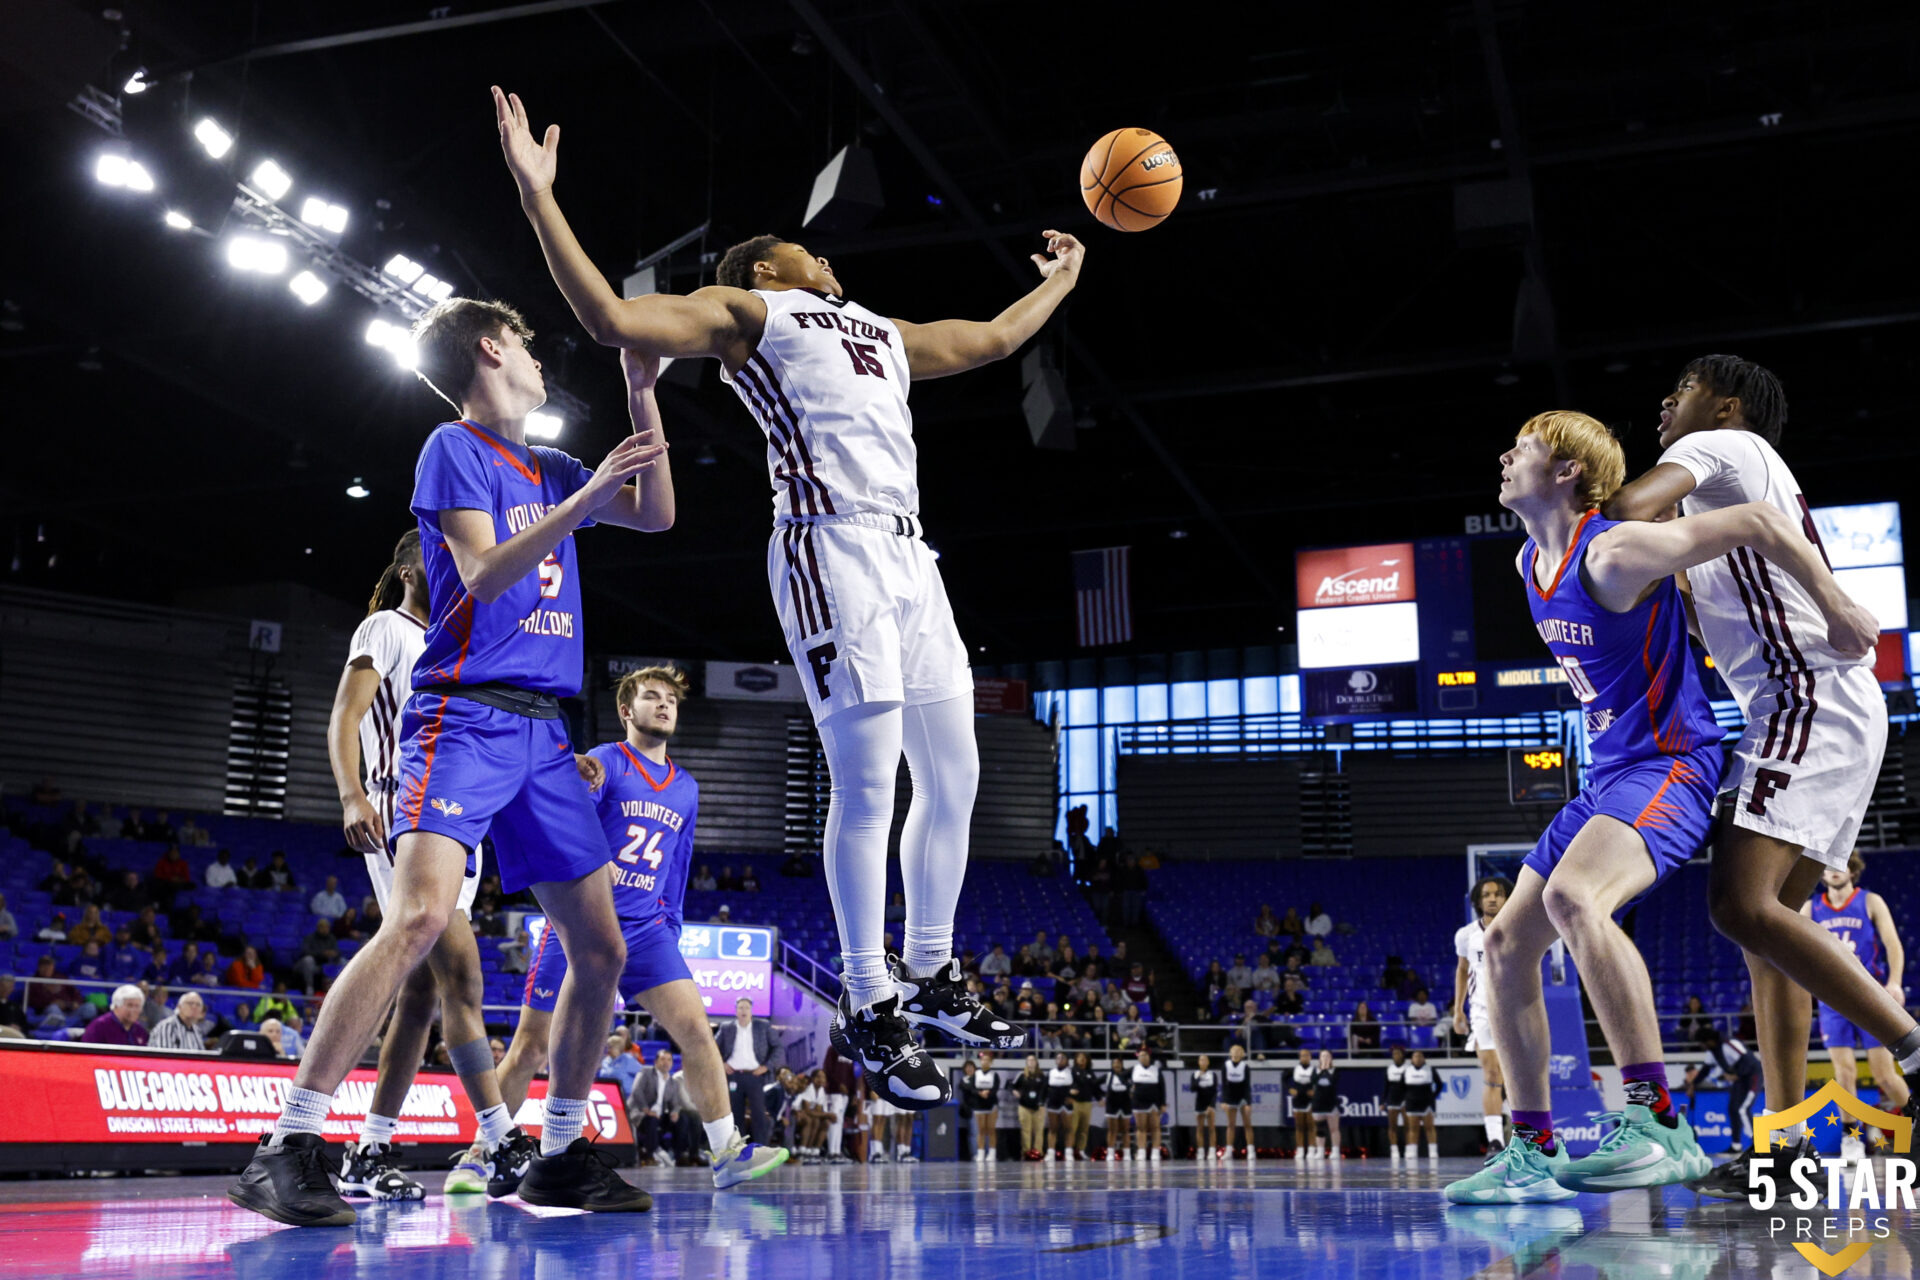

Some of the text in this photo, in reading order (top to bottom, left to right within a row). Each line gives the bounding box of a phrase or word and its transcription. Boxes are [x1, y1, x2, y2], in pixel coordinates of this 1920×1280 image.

[790, 311, 892, 350] FULTON
[841, 338, 888, 380] 15
[1465, 512, 1526, 534] BLU
[538, 550, 563, 599] 5
[1315, 571, 1400, 597] Ascend
[1535, 618, 1595, 646] LUNTEER
[806, 640, 838, 701] F
[1437, 671, 1477, 686] FULTON
[1497, 666, 1571, 687] MIDDLE TEN
[1524, 751, 1562, 770] 4:54
[1746, 767, 1791, 816] F
[620, 799, 684, 832] VOLUNTEER
[617, 823, 665, 871] 24
[617, 867, 656, 892] ALCONS
[736, 933, 753, 956] 2
[692, 968, 765, 991] AT.COM
[94, 1068, 219, 1113] BLUECROSS
[216, 1074, 294, 1115] BASKET
[107, 1116, 156, 1133] DIVISION
[161, 1117, 193, 1134] STATE
[192, 1118, 228, 1134] FINALS
[1552, 1122, 1603, 1142] cend
